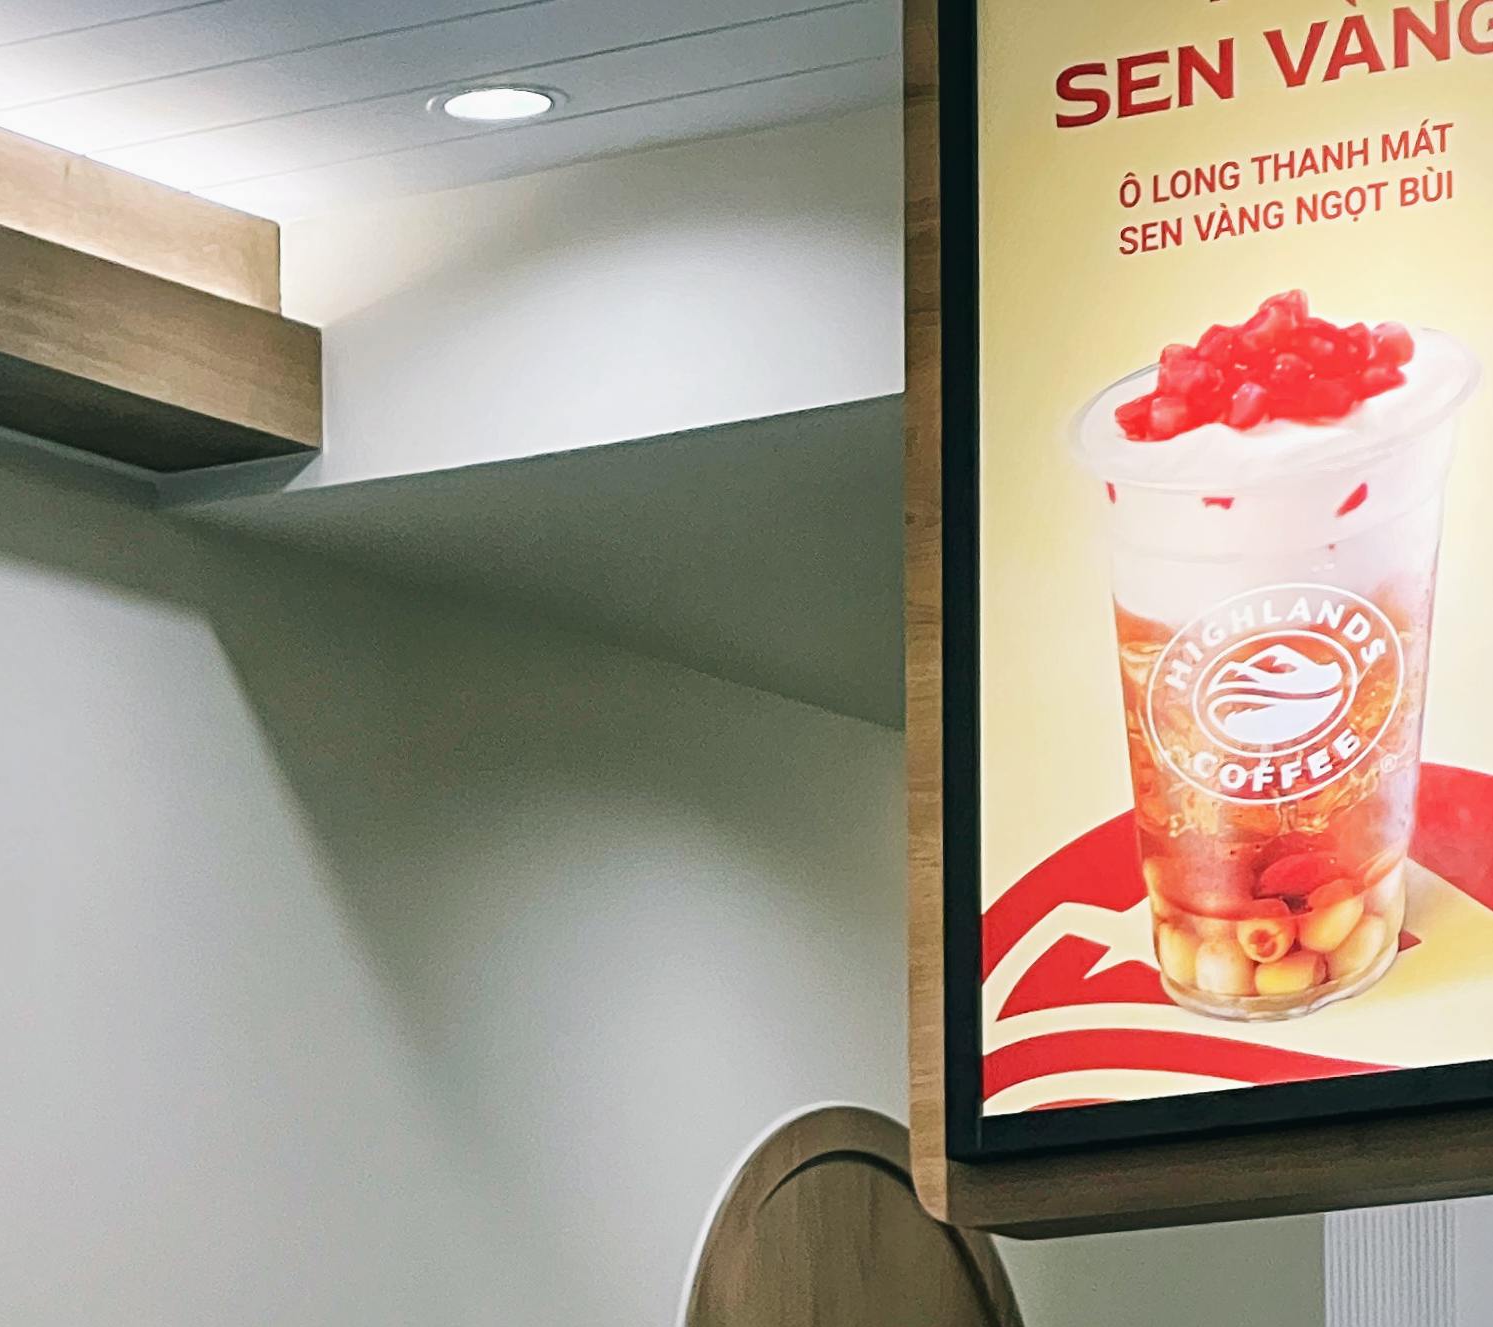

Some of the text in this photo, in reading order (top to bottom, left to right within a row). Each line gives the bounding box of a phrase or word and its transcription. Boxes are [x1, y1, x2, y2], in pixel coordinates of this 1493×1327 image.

[1055, 0, 1493, 128] SEN VÀNG
[1118, 120, 1454, 208] Ô LONG THANH MÁT
[1118, 170, 1454, 255] SEN VÀNG NGỌT BÙI
[1164, 597, 1386, 690] HIGHLANDS
[1193, 728, 1361, 792] COFFEE
